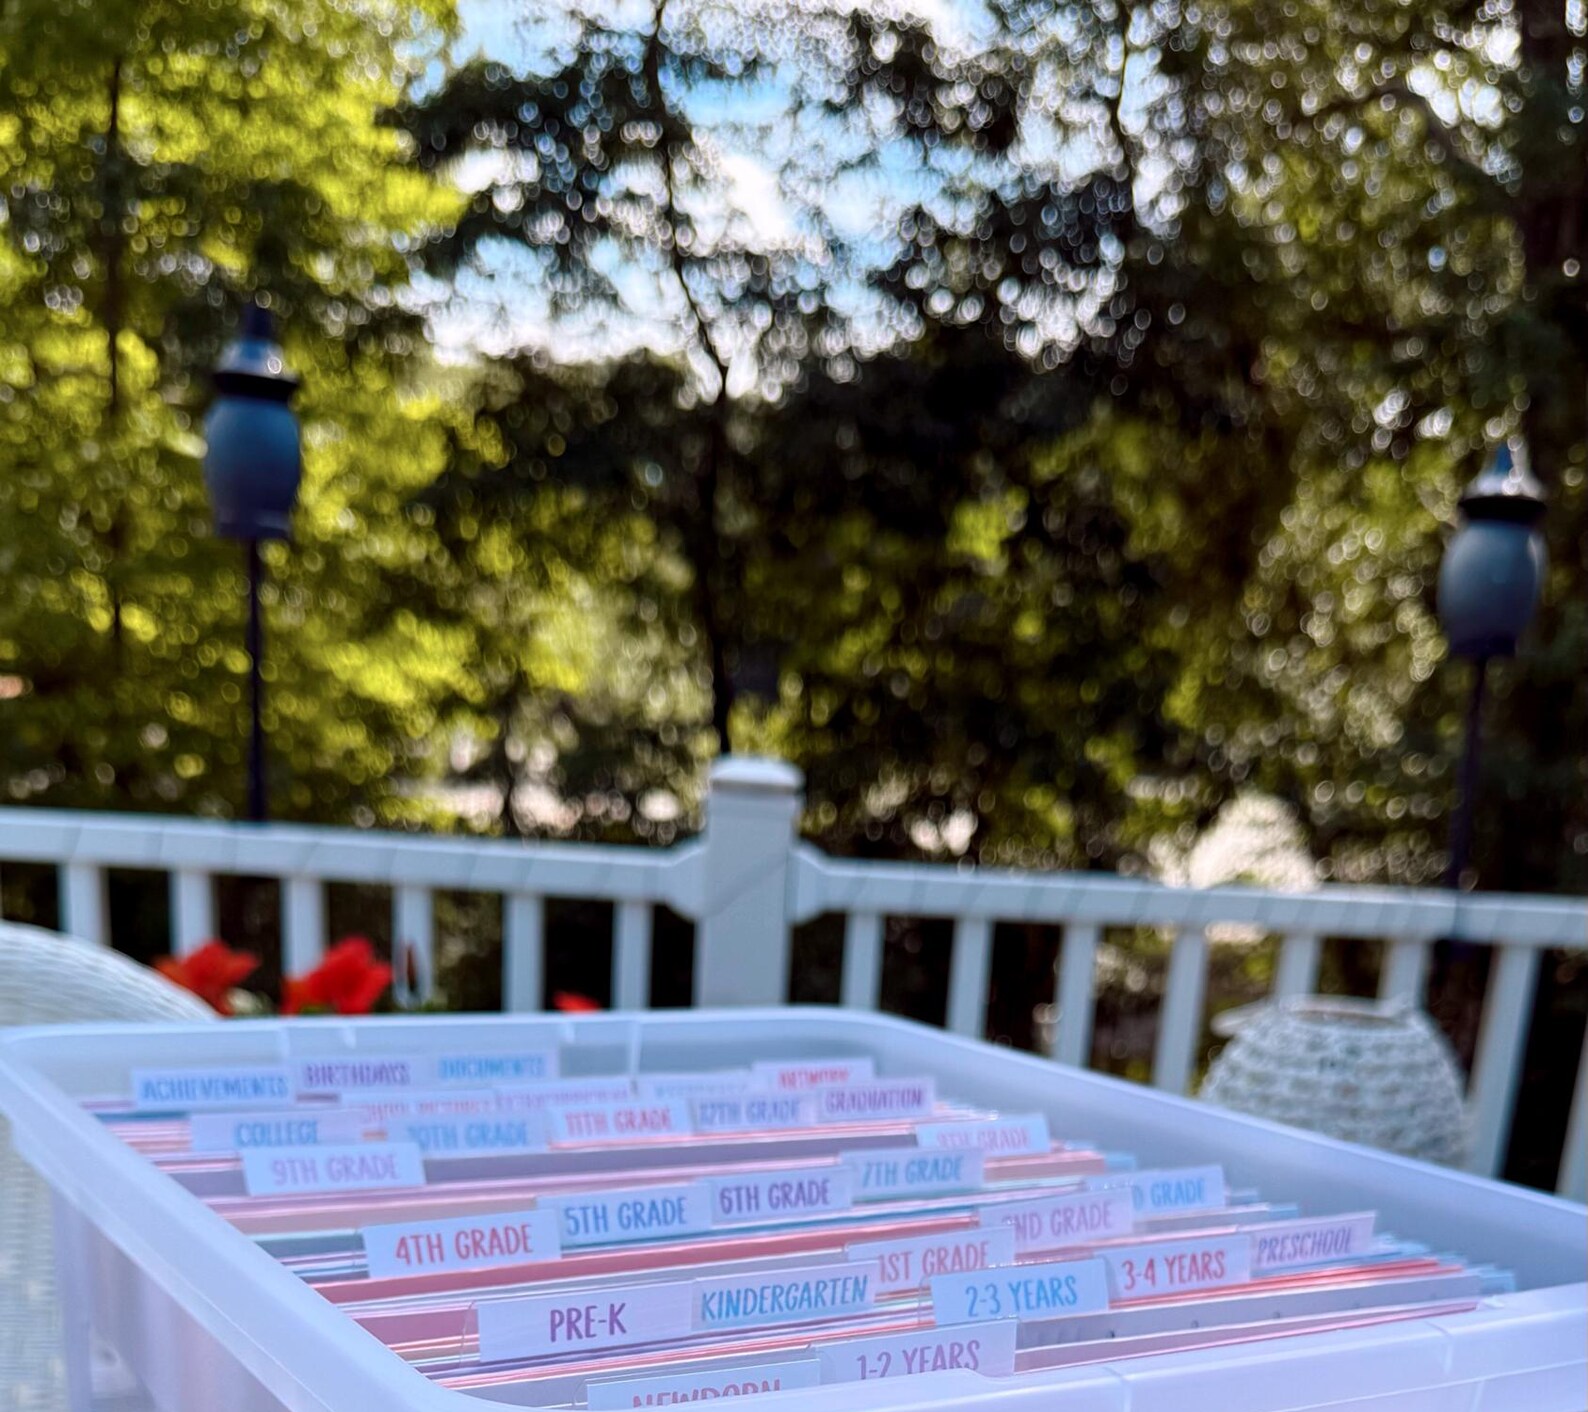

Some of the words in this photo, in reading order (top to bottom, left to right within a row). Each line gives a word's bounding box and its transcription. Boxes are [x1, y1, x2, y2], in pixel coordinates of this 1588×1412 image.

[141, 1075, 289, 1101] ACHIEVEMENTS
[306, 1062, 410, 1086] BIRTHDAYS
[746, 1099, 800, 1125] GRADE
[825, 1088, 923, 1113] GRADUATION
[235, 1121, 318, 1147] COLLEGE
[464, 1121, 527, 1148] GRADE
[564, 1110, 609, 1138] 11TH
[613, 1107, 671, 1132] GRADE
[272, 1158, 316, 1186] 9TH
[325, 1153, 399, 1182] GRADE
[862, 1162, 897, 1187] 7TH
[905, 1156, 964, 1183] GRADE
[720, 1184, 759, 1215] 6TH
[769, 1178, 830, 1209] GRADE
[564, 1204, 607, 1237] 5TH
[618, 1197, 687, 1230] GRADE
[1004, 1212, 1042, 1241] ND
[1051, 1202, 1112, 1237] GRADE
[395, 1233, 443, 1266] 4TH
[455, 1225, 532, 1260] GRADE
[878, 1250, 912, 1284] 1ST
[922, 1241, 988, 1277] GRADE
[1257, 1225, 1352, 1265] PRESCHOOL
[1122, 1260, 1156, 1291] 3-4
[1164, 1250, 1225, 1283] YEARS
[702, 1275, 868, 1322] KINDERGARTEN
[966, 1283, 1001, 1318] 2-3
[1009, 1275, 1078, 1310] YEARS
[550, 1303, 627, 1343] PRE-K
[856, 1352, 891, 1380] 1-2
[902, 1340, 980, 1375] YEARS
